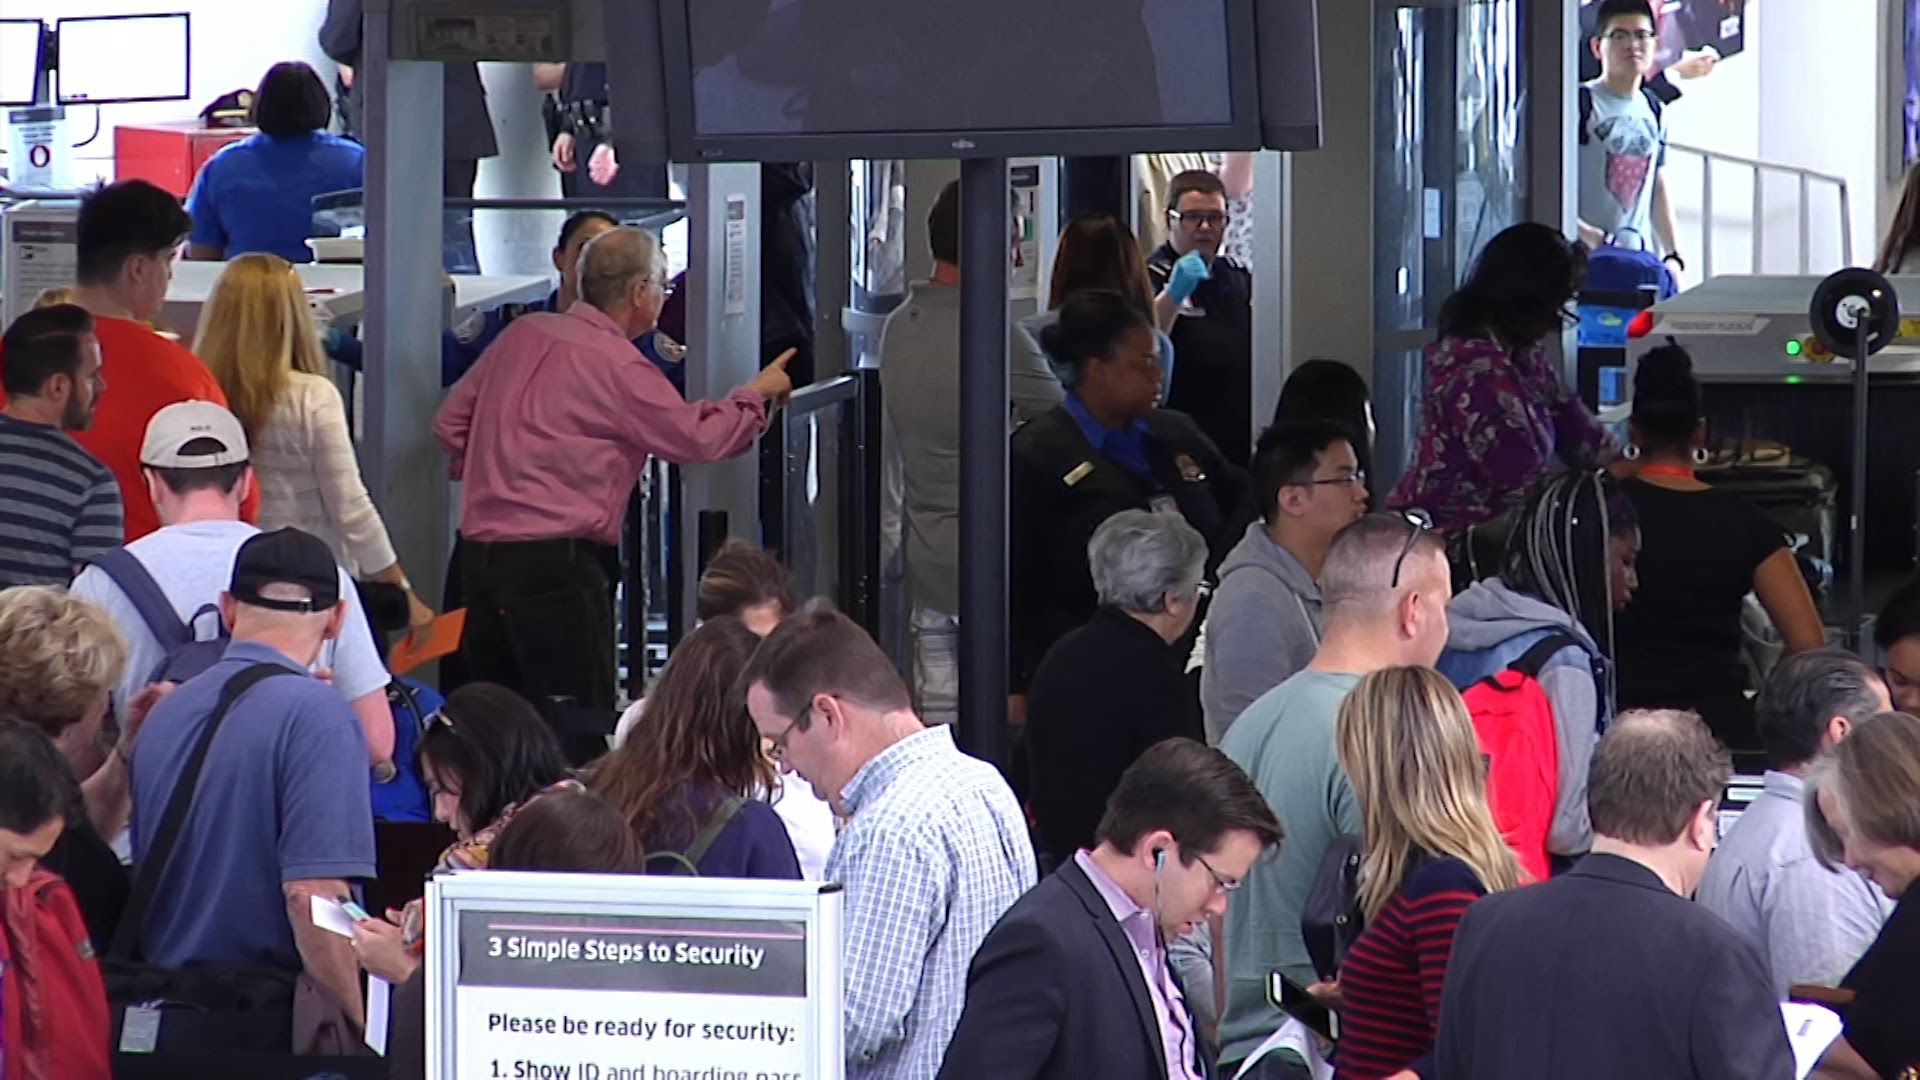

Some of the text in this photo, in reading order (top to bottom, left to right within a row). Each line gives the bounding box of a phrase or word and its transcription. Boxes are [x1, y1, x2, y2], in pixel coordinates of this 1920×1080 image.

[488, 936, 765, 970] 3 Simple Steps to Security
[488, 1013, 795, 1046] Please be ready for security:
[490, 1058, 508, 1078] 1.
[514, 1059, 571, 1080] Show
[579, 1062, 600, 1080] ID
[607, 1064, 646, 1080] and
